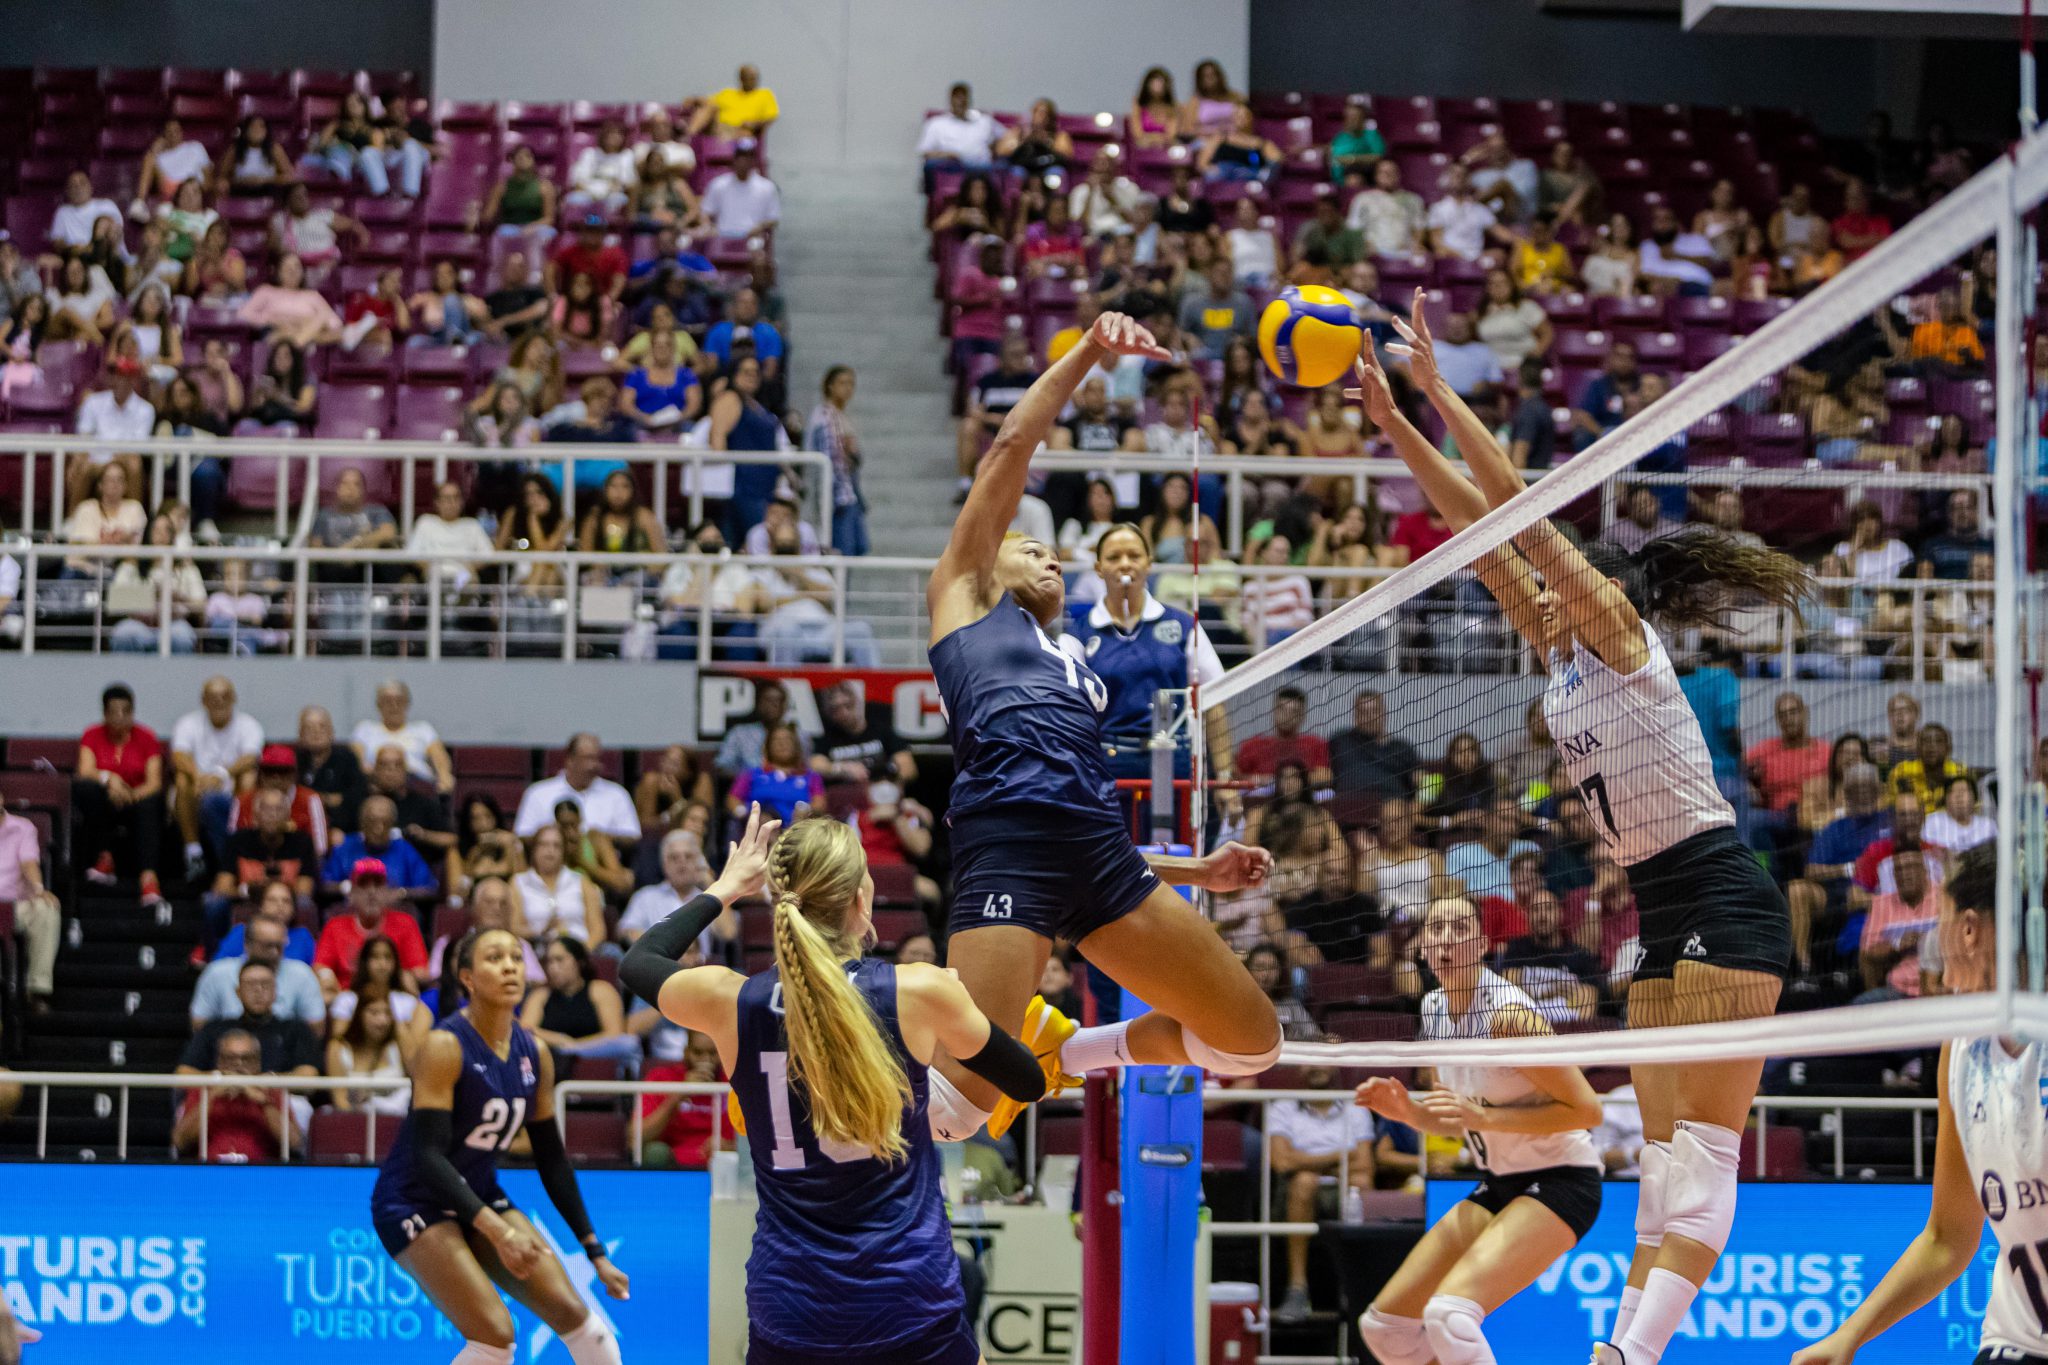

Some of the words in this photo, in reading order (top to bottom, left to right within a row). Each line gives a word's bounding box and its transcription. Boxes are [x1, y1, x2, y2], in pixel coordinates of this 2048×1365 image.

[983, 893, 1013, 918] 43
[464, 1097, 526, 1152] 21
[0, 1235, 176, 1279] TURIS
[291, 1308, 422, 1340] PUERTO
